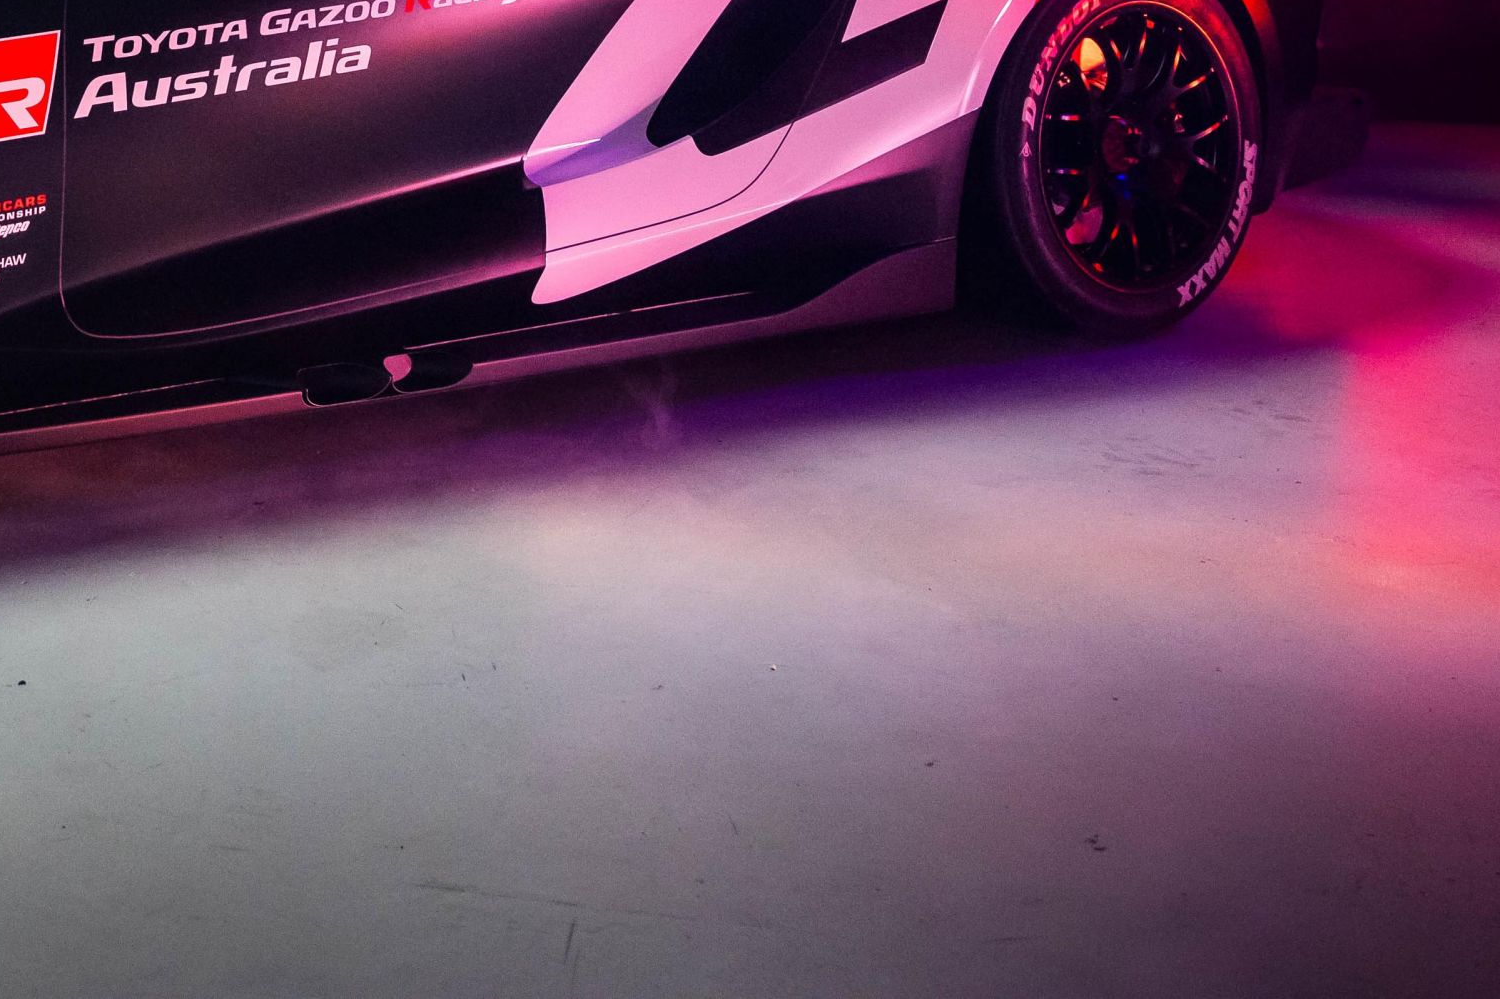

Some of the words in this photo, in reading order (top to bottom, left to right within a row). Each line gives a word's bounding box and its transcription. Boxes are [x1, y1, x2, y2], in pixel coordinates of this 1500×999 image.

[72, 38, 373, 120] Australia
[82, 19, 248, 63] TOYOTA
[1228, 139, 1258, 243] SPORT
[1176, 236, 1231, 307] MAXX
